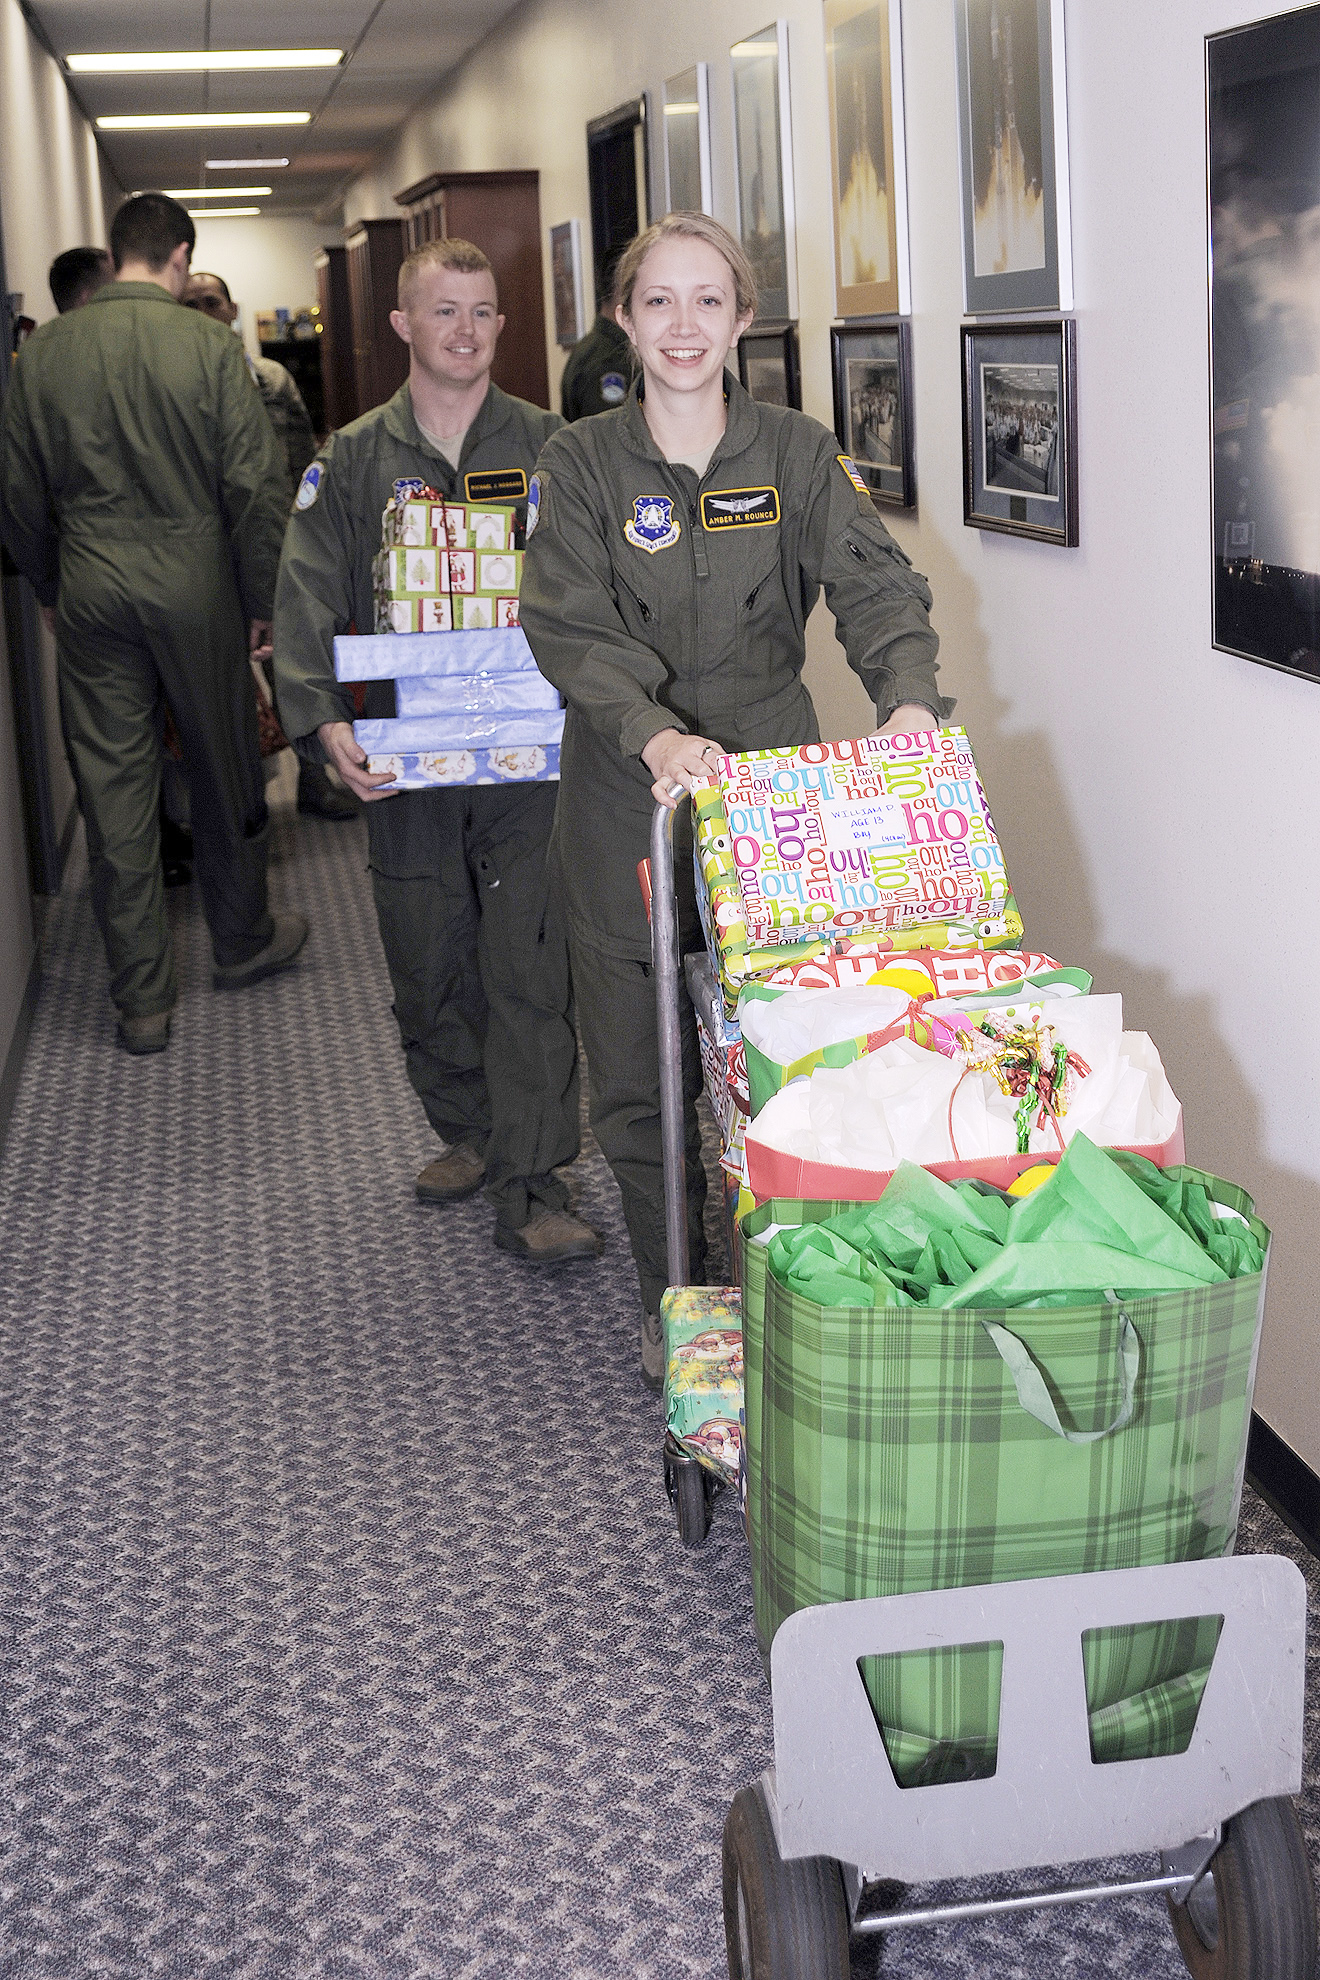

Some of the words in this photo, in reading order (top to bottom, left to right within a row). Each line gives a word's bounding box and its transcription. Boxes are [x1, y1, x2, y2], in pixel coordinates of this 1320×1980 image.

[708, 515, 733, 525] AMBER
[735, 514, 743, 522] M.
[744, 510, 774, 521] ROUNCE
[830, 806, 883, 819] WILLIAM
[850, 817, 870, 828] AGE
[873, 816, 884, 825] 13
